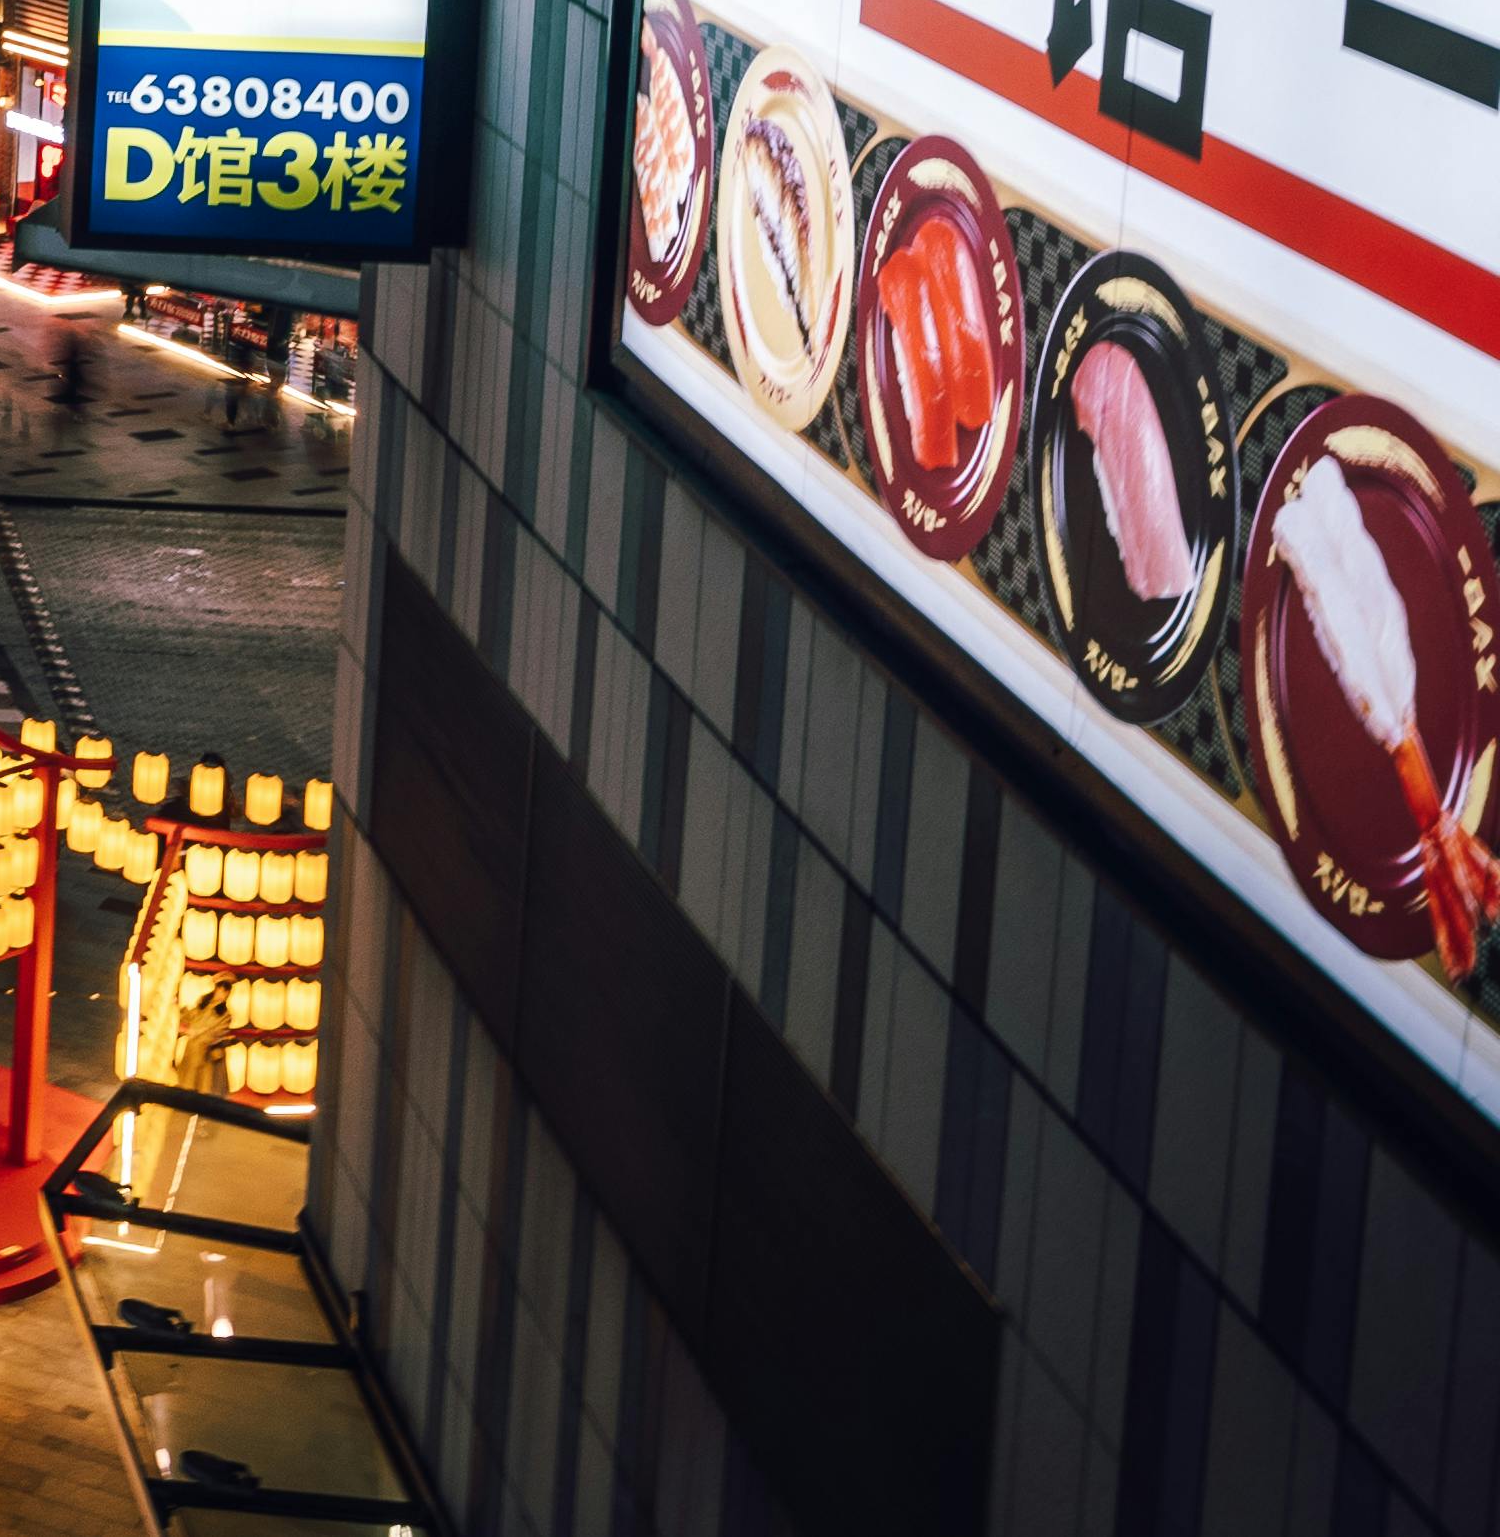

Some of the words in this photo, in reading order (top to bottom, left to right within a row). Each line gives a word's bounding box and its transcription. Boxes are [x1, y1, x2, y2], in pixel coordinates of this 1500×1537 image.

[106, 89, 130, 106] TEL
[129, 72, 409, 125] 63808400
[104, 125, 408, 215] D馆3楼
[1312, 850, 1385, 917] スシロー
